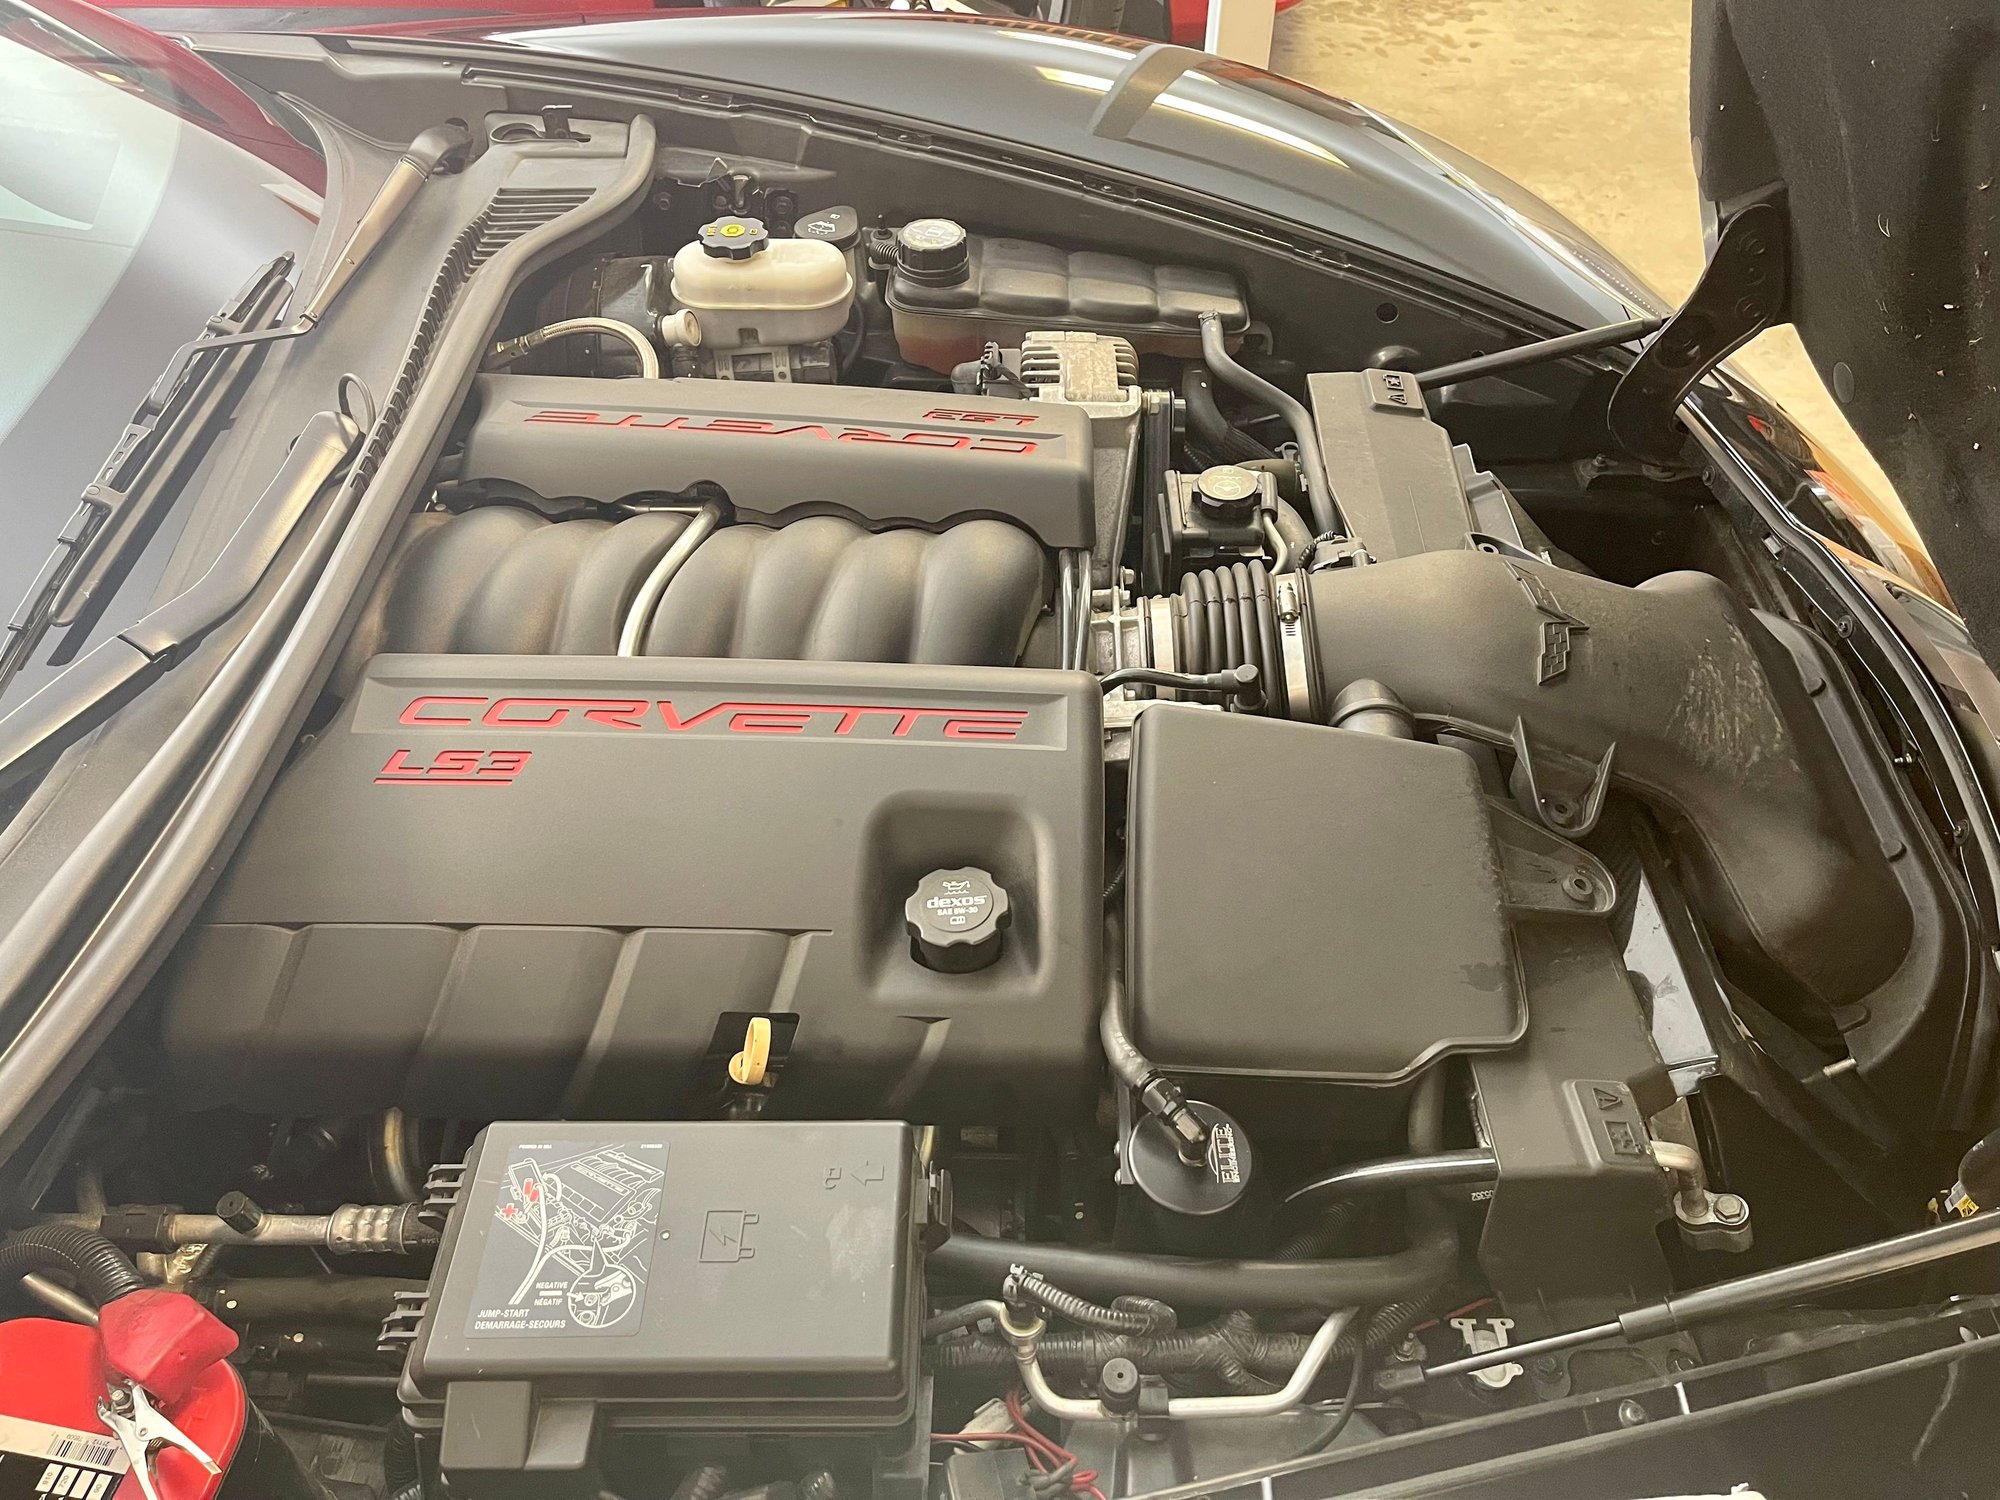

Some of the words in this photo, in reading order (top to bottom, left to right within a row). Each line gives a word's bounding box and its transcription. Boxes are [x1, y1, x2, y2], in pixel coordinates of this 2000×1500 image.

[922, 408, 1040, 427] LS3
[523, 410, 1040, 454] CORVETTE
[399, 695, 1029, 740] CORVETTE
[381, 749, 533, 776] LS3
[926, 895, 988, 909] dexos
[1216, 1126, 1234, 1184] ELITE
[535, 1281, 569, 1289] NEGATIVE
[477, 1308, 530, 1318] JUMP-START
